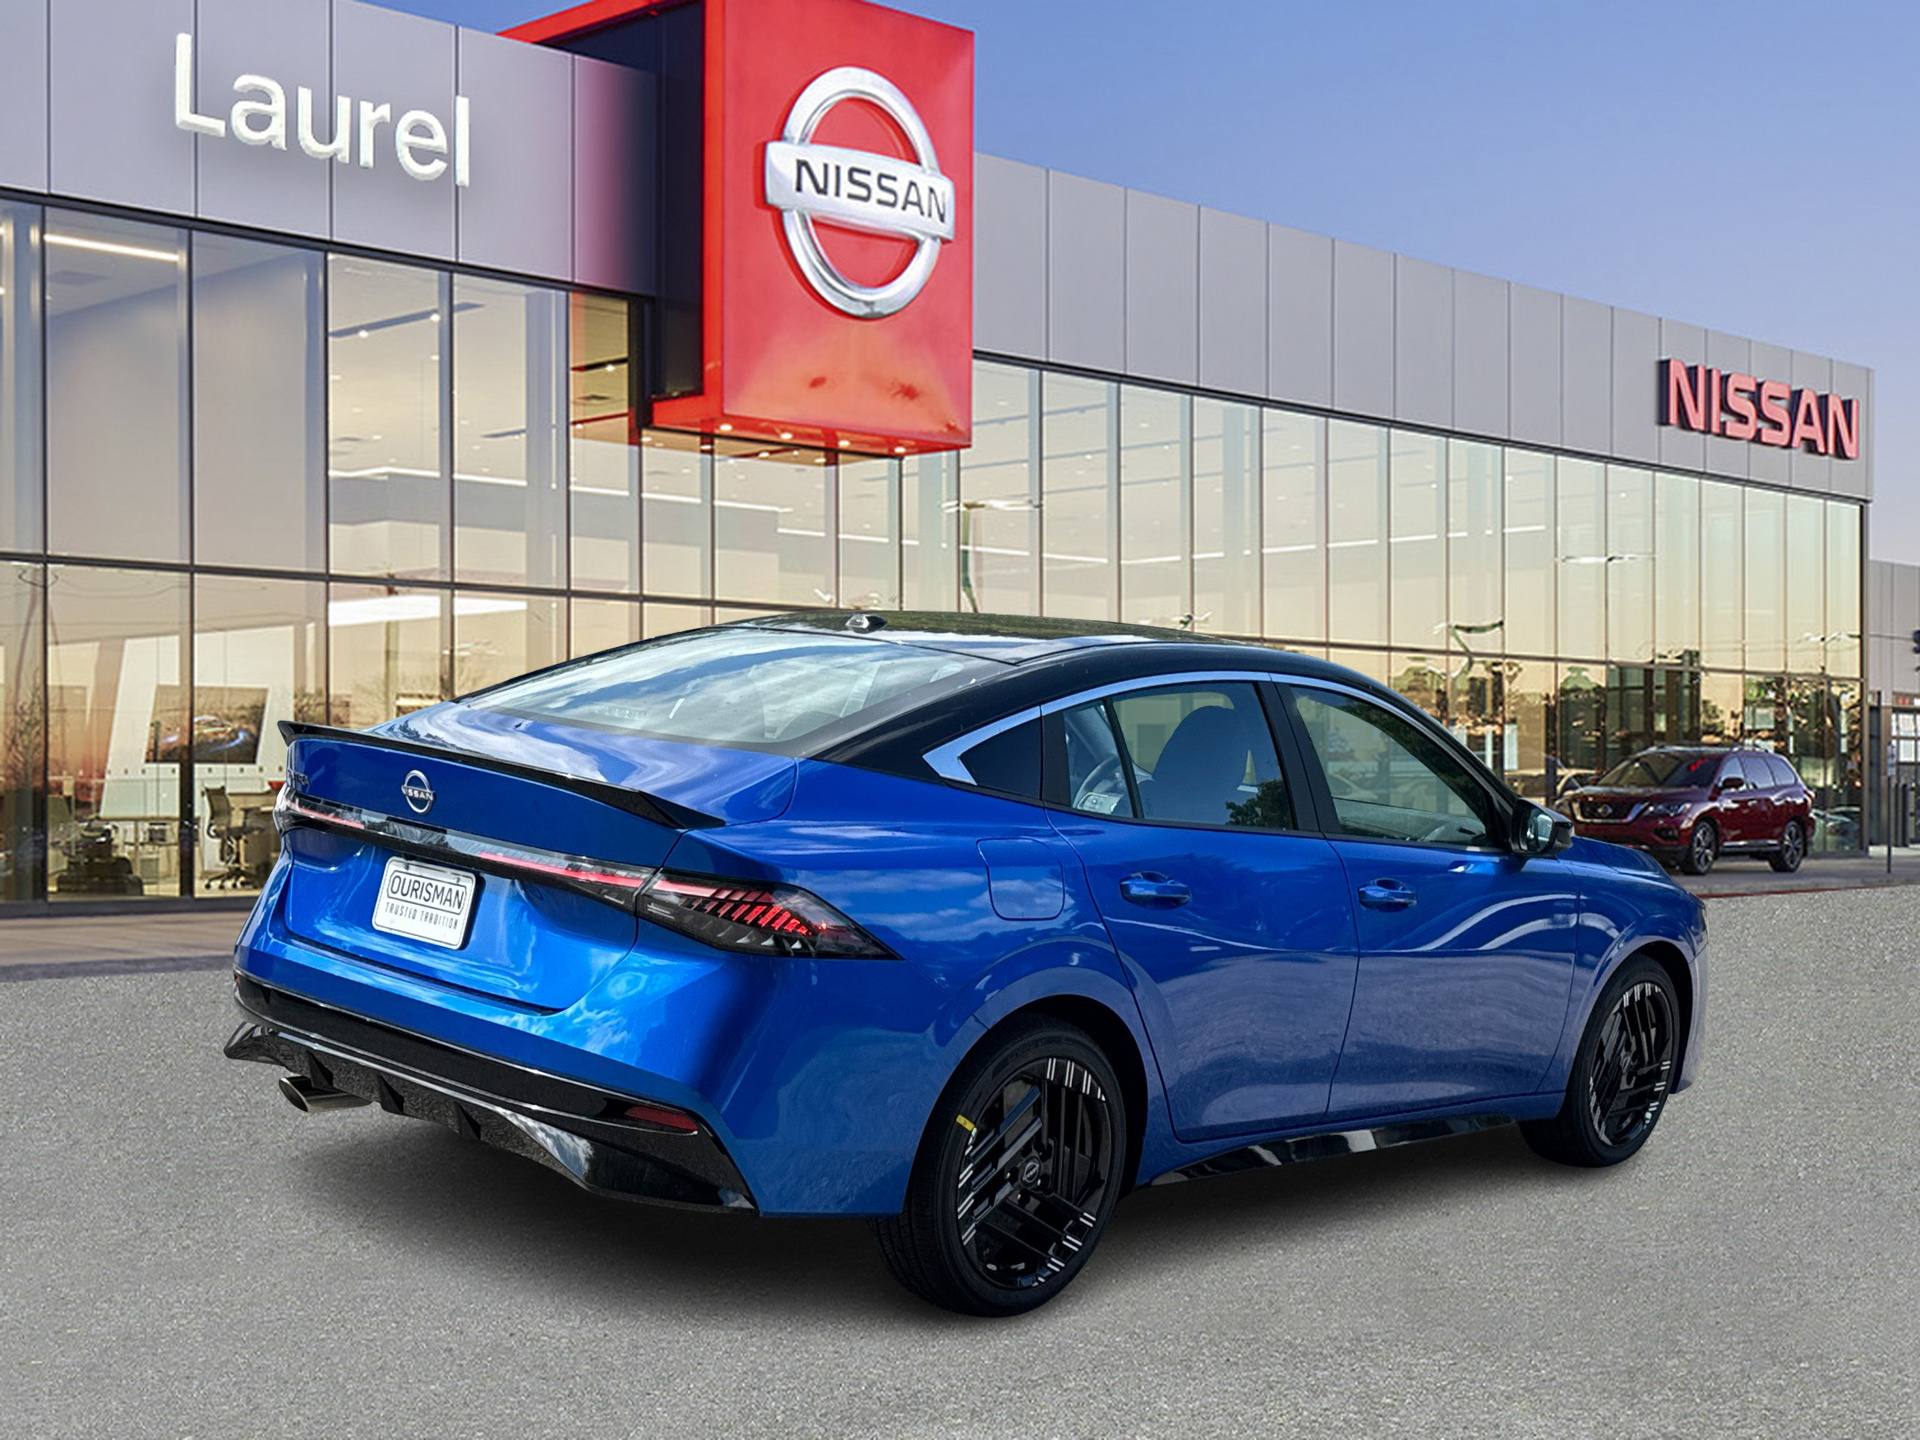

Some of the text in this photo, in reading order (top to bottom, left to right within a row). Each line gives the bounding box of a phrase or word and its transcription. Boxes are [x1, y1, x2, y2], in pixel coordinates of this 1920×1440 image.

[175, 33, 470, 188] Laurel
[795, 158, 947, 224] NISSAN
[1658, 358, 1859, 460] NISSAN
[385, 902, 459, 930] TRUSTED TRADITION
[390, 875, 465, 910] OURISMAN
